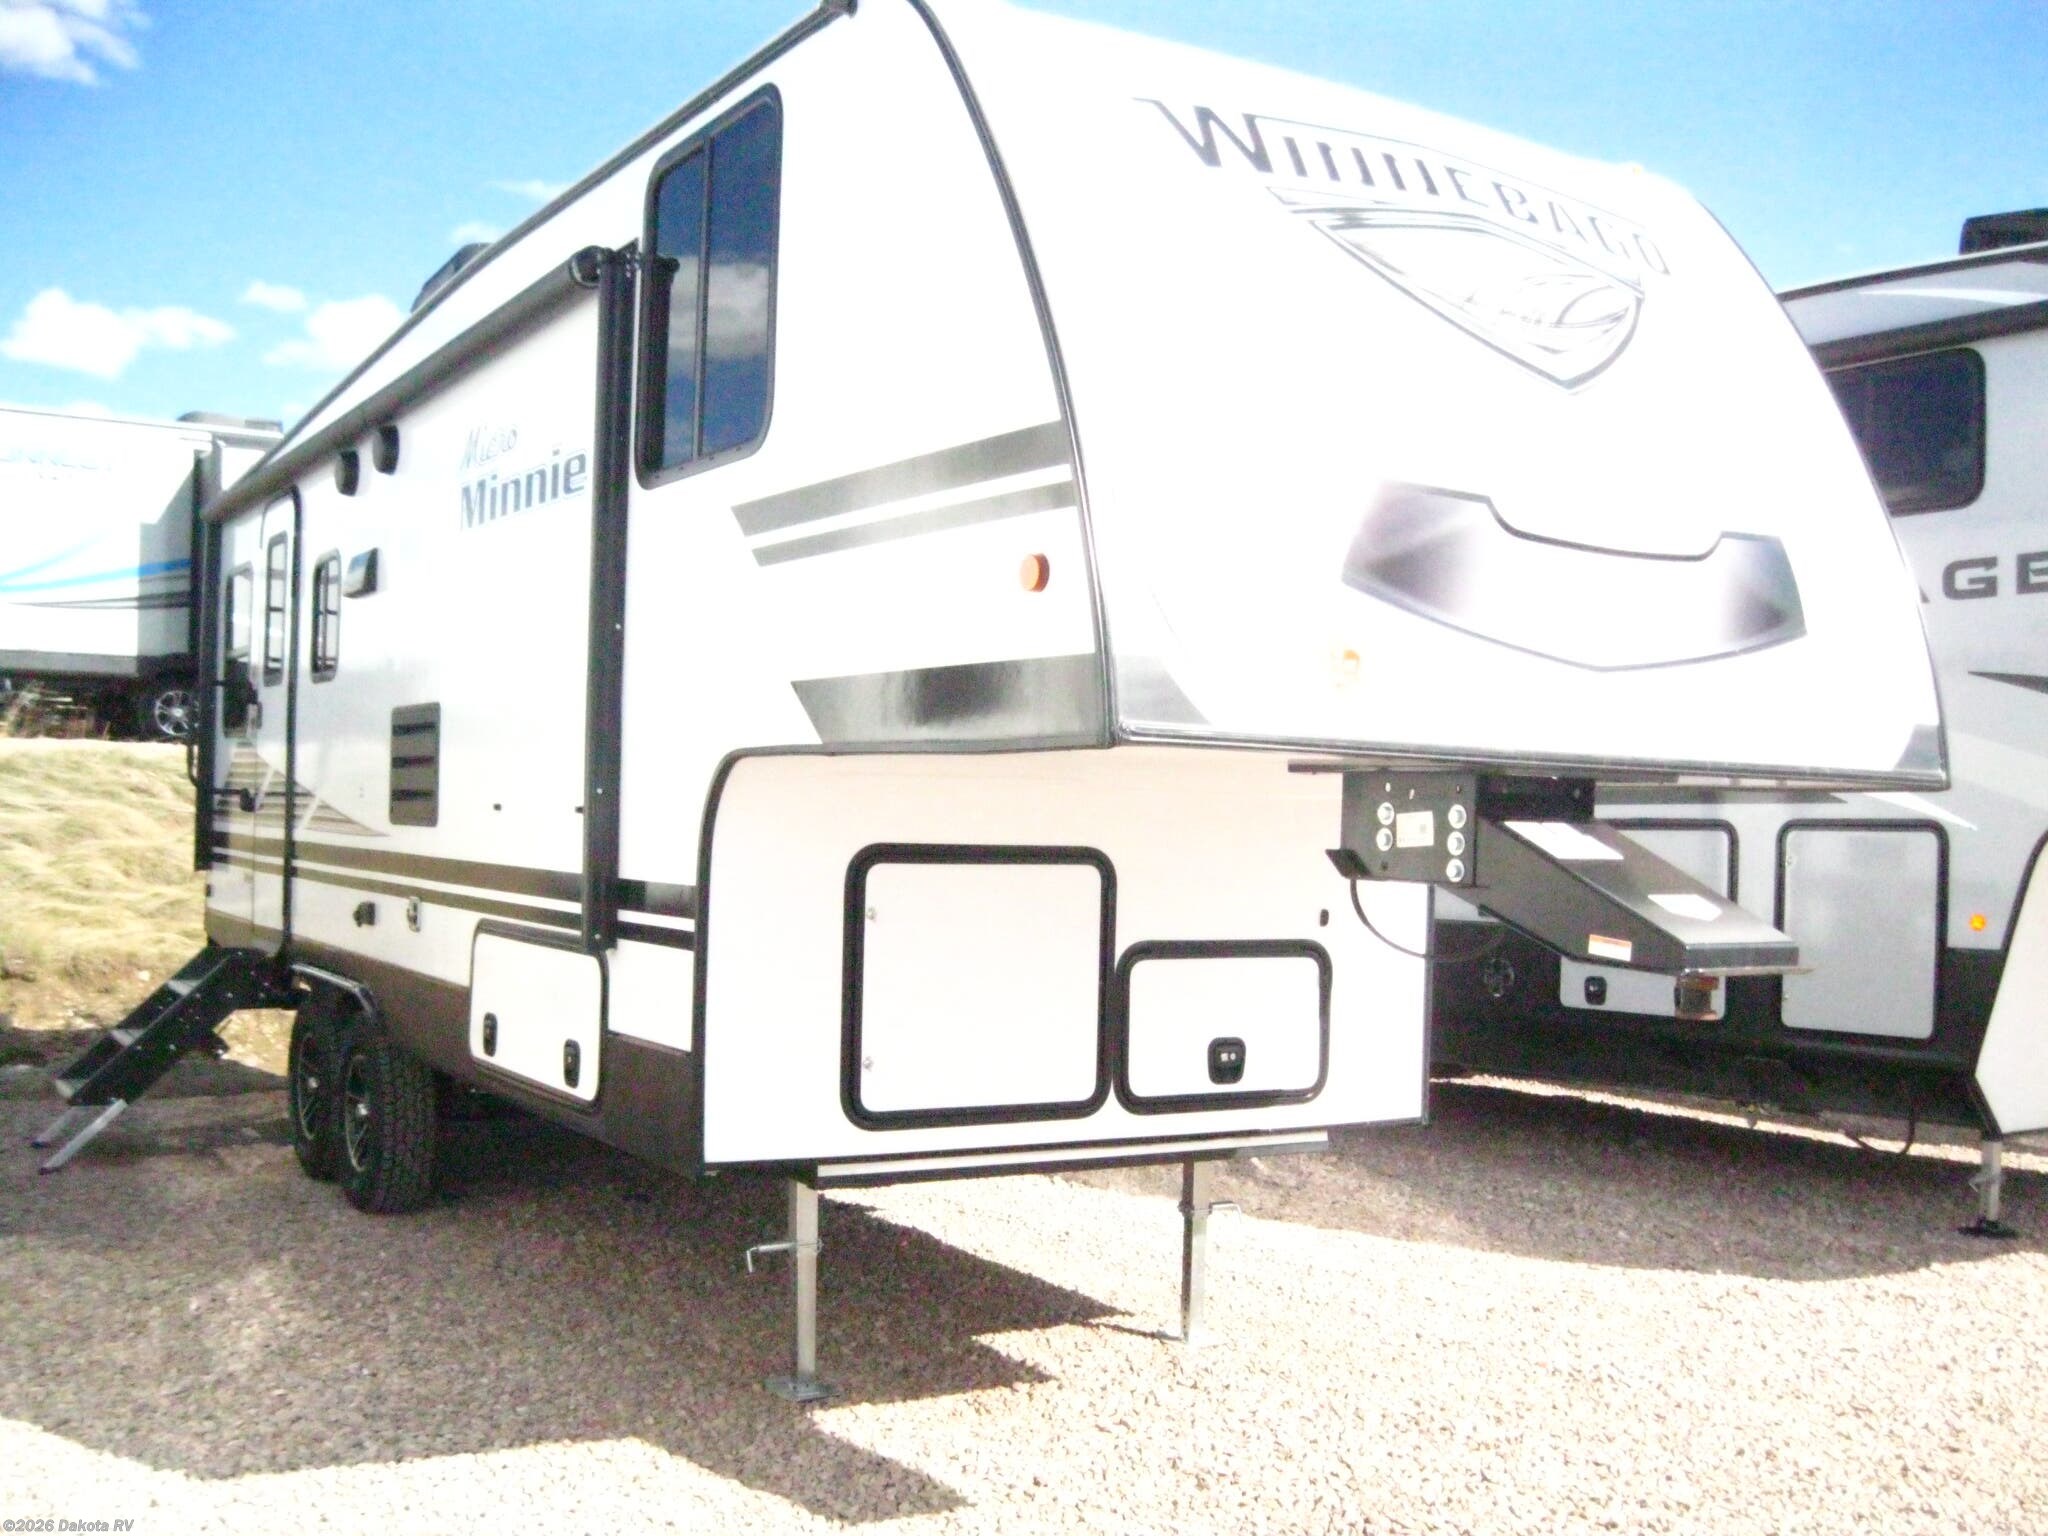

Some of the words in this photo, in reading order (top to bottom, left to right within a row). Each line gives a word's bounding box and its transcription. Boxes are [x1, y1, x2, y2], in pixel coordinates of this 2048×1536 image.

[1132, 97, 1671, 276] WINNEBAGO
[460, 448, 588, 530] Minnie
[1918, 550, 2048, 604] GE
